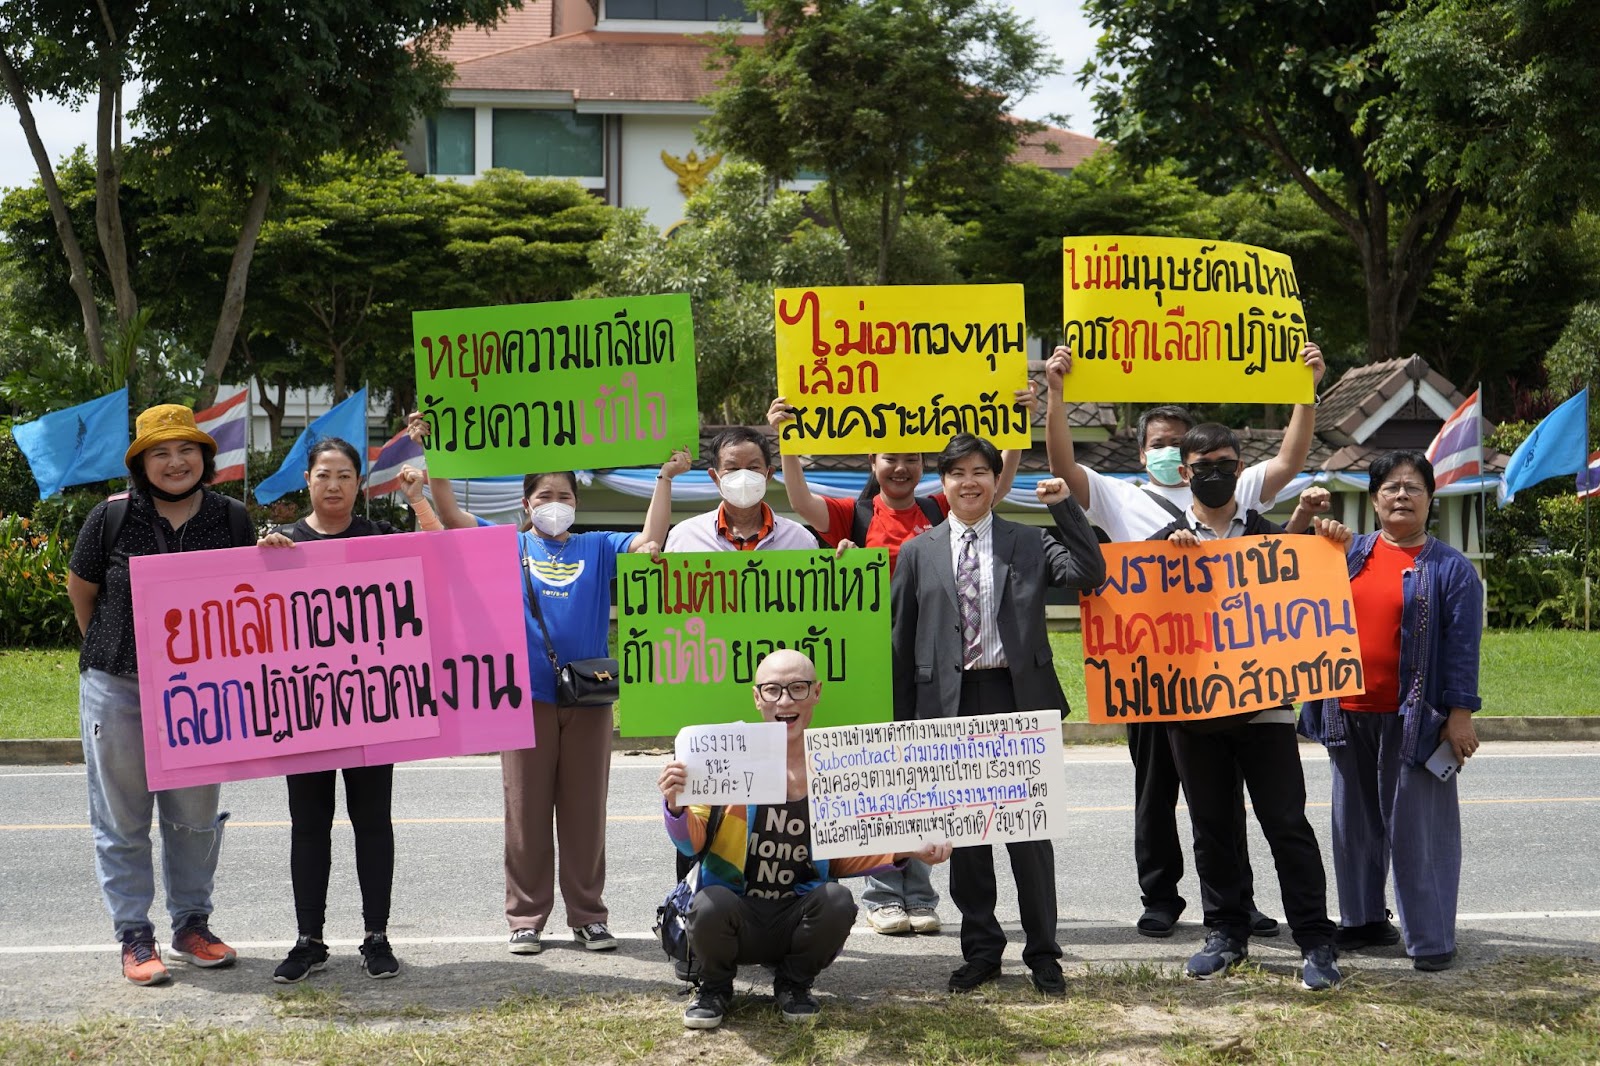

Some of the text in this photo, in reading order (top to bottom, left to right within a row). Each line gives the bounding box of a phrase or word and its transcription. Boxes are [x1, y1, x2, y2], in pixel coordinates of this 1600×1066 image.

[1065, 243, 1301, 307] ไม่มีมนุษย์คนไหน
[421, 308, 676, 392] หยุดความเกลียด
[778, 291, 1025, 372] ไม่เอากองทุน
[1064, 305, 1308, 375] ควรถูกเลือกปฏิบัติ
[799, 357, 879, 395] เลือก
[420, 371, 668, 452] ด้วยความเข้าใจ
[782, 390, 1028, 441] สงเคราะห์ลกจ้าง
[623, 553, 886, 616] เราไม่ต่างกันเท่าไหร่
[1081, 535, 1299, 597] พราะเราเชื่อ
[164, 579, 423, 665] ยกเลิกกองทุน
[1085, 646, 1362, 717] ไม่ใช่แค่สัญชาติ
[689, 734, 747, 753] แรงงาน
[705, 757, 731, 775] ชนะ
[765, 807, 805, 836] No
[756, 860, 795, 885] No
